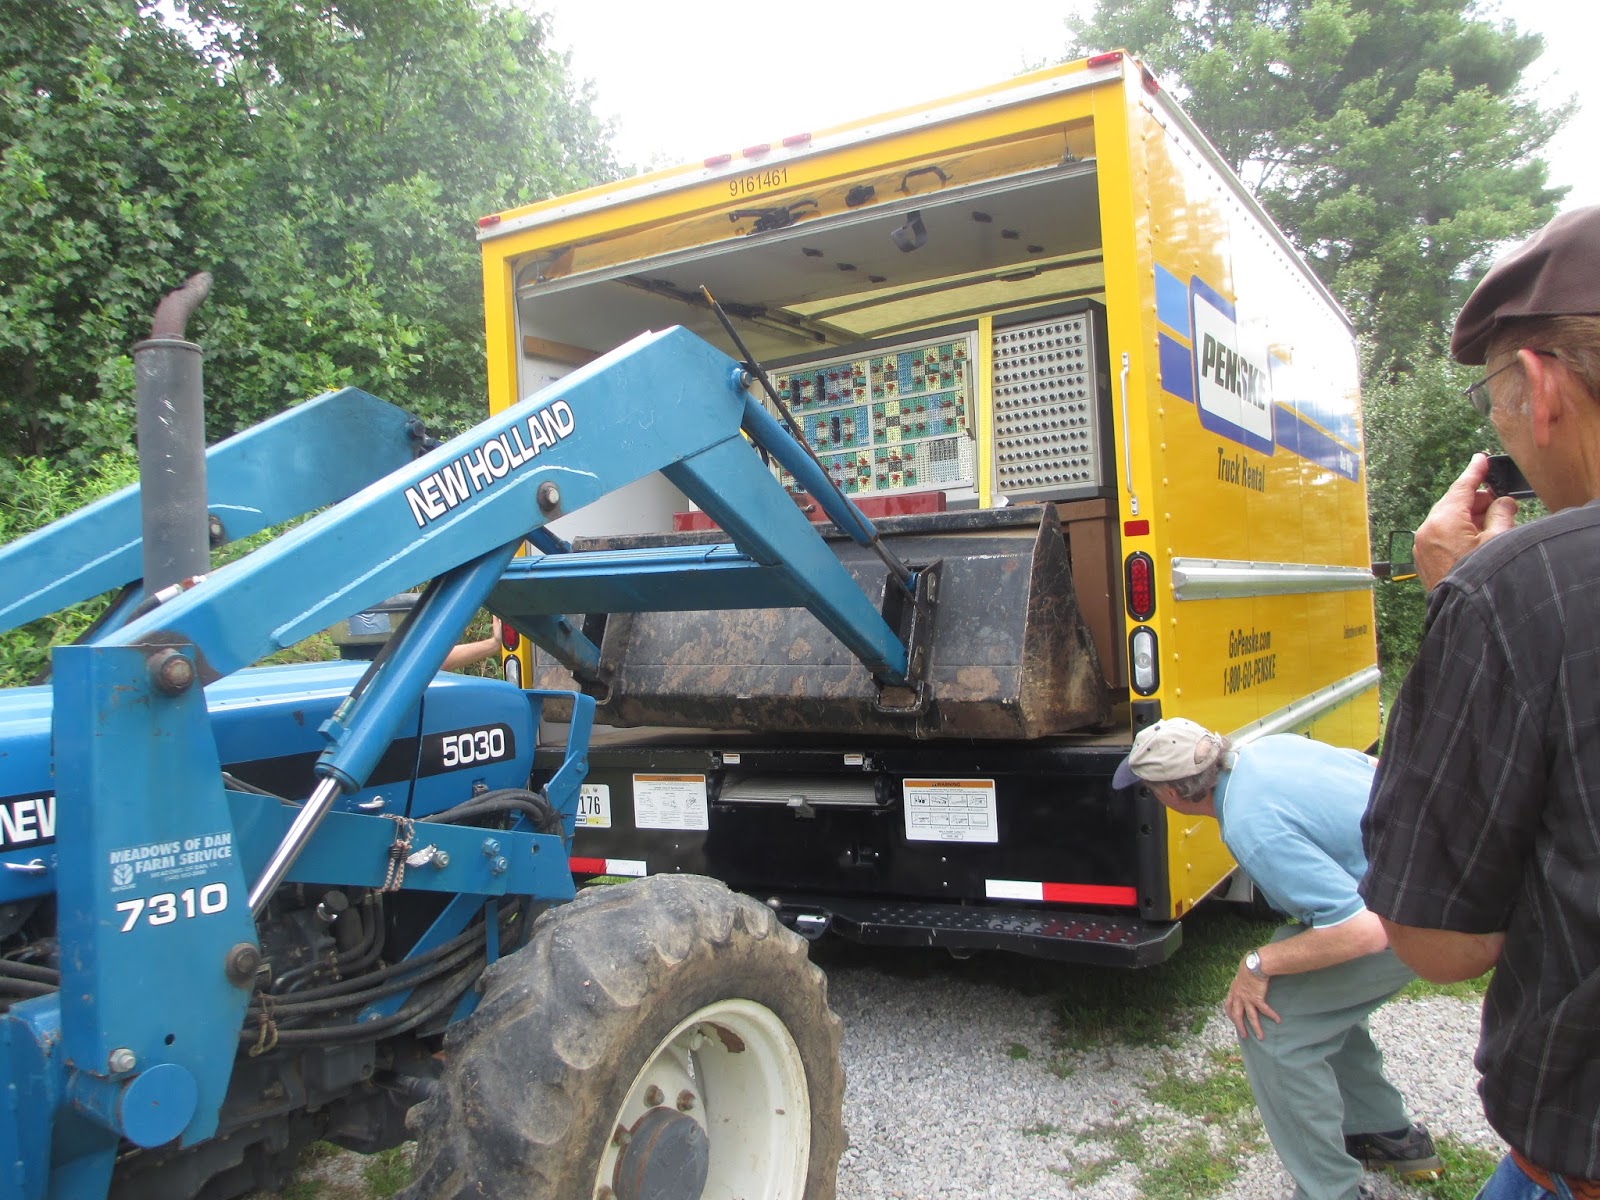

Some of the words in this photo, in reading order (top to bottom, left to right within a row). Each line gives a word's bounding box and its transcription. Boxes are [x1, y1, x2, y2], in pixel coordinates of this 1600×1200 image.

[729, 167, 788, 197] 9161461
[1201, 331, 1267, 411] PENSKE
[404, 458, 472, 529] NEW
[462, 399, 576, 493] HOLLAND
[1217, 446, 1240, 488] Truck
[1241, 453, 1265, 493] Rental
[1229, 626, 1271, 659] GoPenske.com
[1223, 653, 1276, 696] 1-800-GO-PENSKE
[442, 728, 505, 767] 5030
[110, 841, 180, 864] MEADOWS
[184, 838, 201, 851] OF
[204, 832, 232, 848] DAN
[134, 855, 175, 873] FARM
[179, 846, 232, 866] SERVICE
[116, 882, 228, 933] 7310
